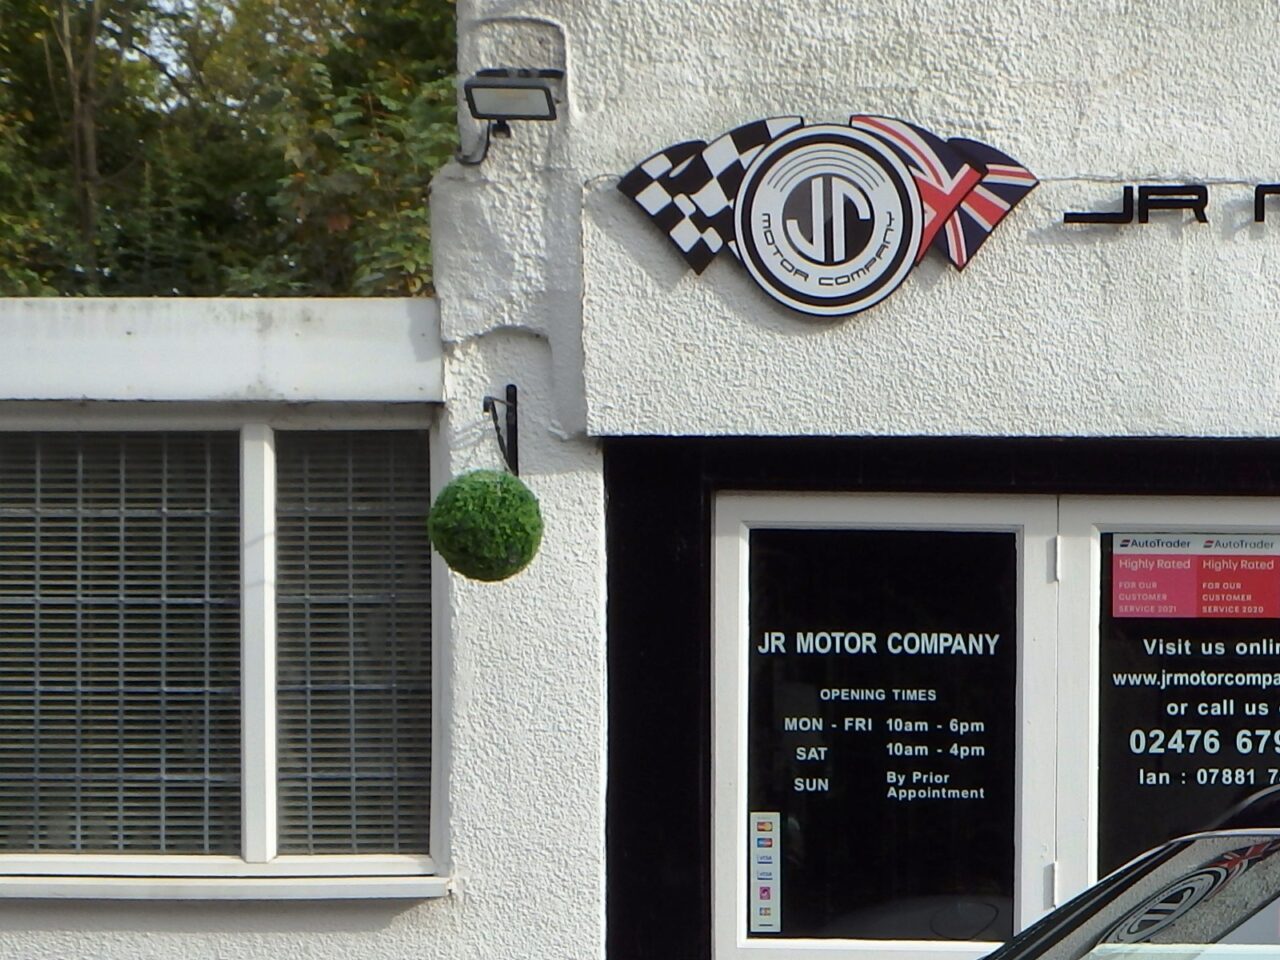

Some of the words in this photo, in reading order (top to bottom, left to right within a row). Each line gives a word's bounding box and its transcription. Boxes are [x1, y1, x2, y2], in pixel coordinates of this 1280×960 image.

[1063, 184, 1209, 224] JR
[762, 213, 809, 282] MOTOR
[818, 211, 895, 287] COMPANY
[1131, 539, 1191, 549] AutoTrader
[1214, 539, 1274, 549] AutoTrader
[1119, 559, 1155, 571] Highly
[1157, 559, 1191, 569] Rated
[1203, 559, 1238, 572] Highly
[1241, 559, 1274, 570] Rated
[1119, 581, 1136, 590] FOR
[1139, 581, 1157, 590] OUR
[1202, 582, 1220, 590] FOR
[1222, 582, 1242, 590] OUR
[1118, 593, 1167, 601] CUSTOMER
[1202, 594, 1252, 602] CUSTOMER
[1118, 605, 1155, 613] SERVICE
[1202, 605, 1240, 614] SERVICE
[1242, 605, 1264, 614] 2020
[757, 632, 786, 654] JR
[796, 632, 877, 654] MOTOR
[887, 633, 999, 655] COMPANY
[1143, 639, 1191, 655] Visit
[1201, 643, 1225, 655] us
[820, 688, 885, 701] OPENING
[892, 689, 937, 701] TIMES
[1167, 703, 1188, 715] or
[1198, 699, 1234, 715] call
[1245, 703, 1269, 715] us
[784, 718, 823, 731] MON
[844, 718, 872, 731] FRI
[886, 718, 928, 732] 10am
[949, 718, 985, 735] 6pm
[1129, 729, 1220, 754] 02476
[796, 747, 828, 761] SAT
[886, 742, 928, 756] 10am
[949, 743, 985, 760] 4pm
[886, 771, 906, 786] By
[912, 771, 950, 784] Prior
[1139, 769, 1170, 785] Ian
[1197, 769, 1255, 785] 07881
[794, 778, 829, 792] SUN
[887, 786, 985, 801] Appointment
